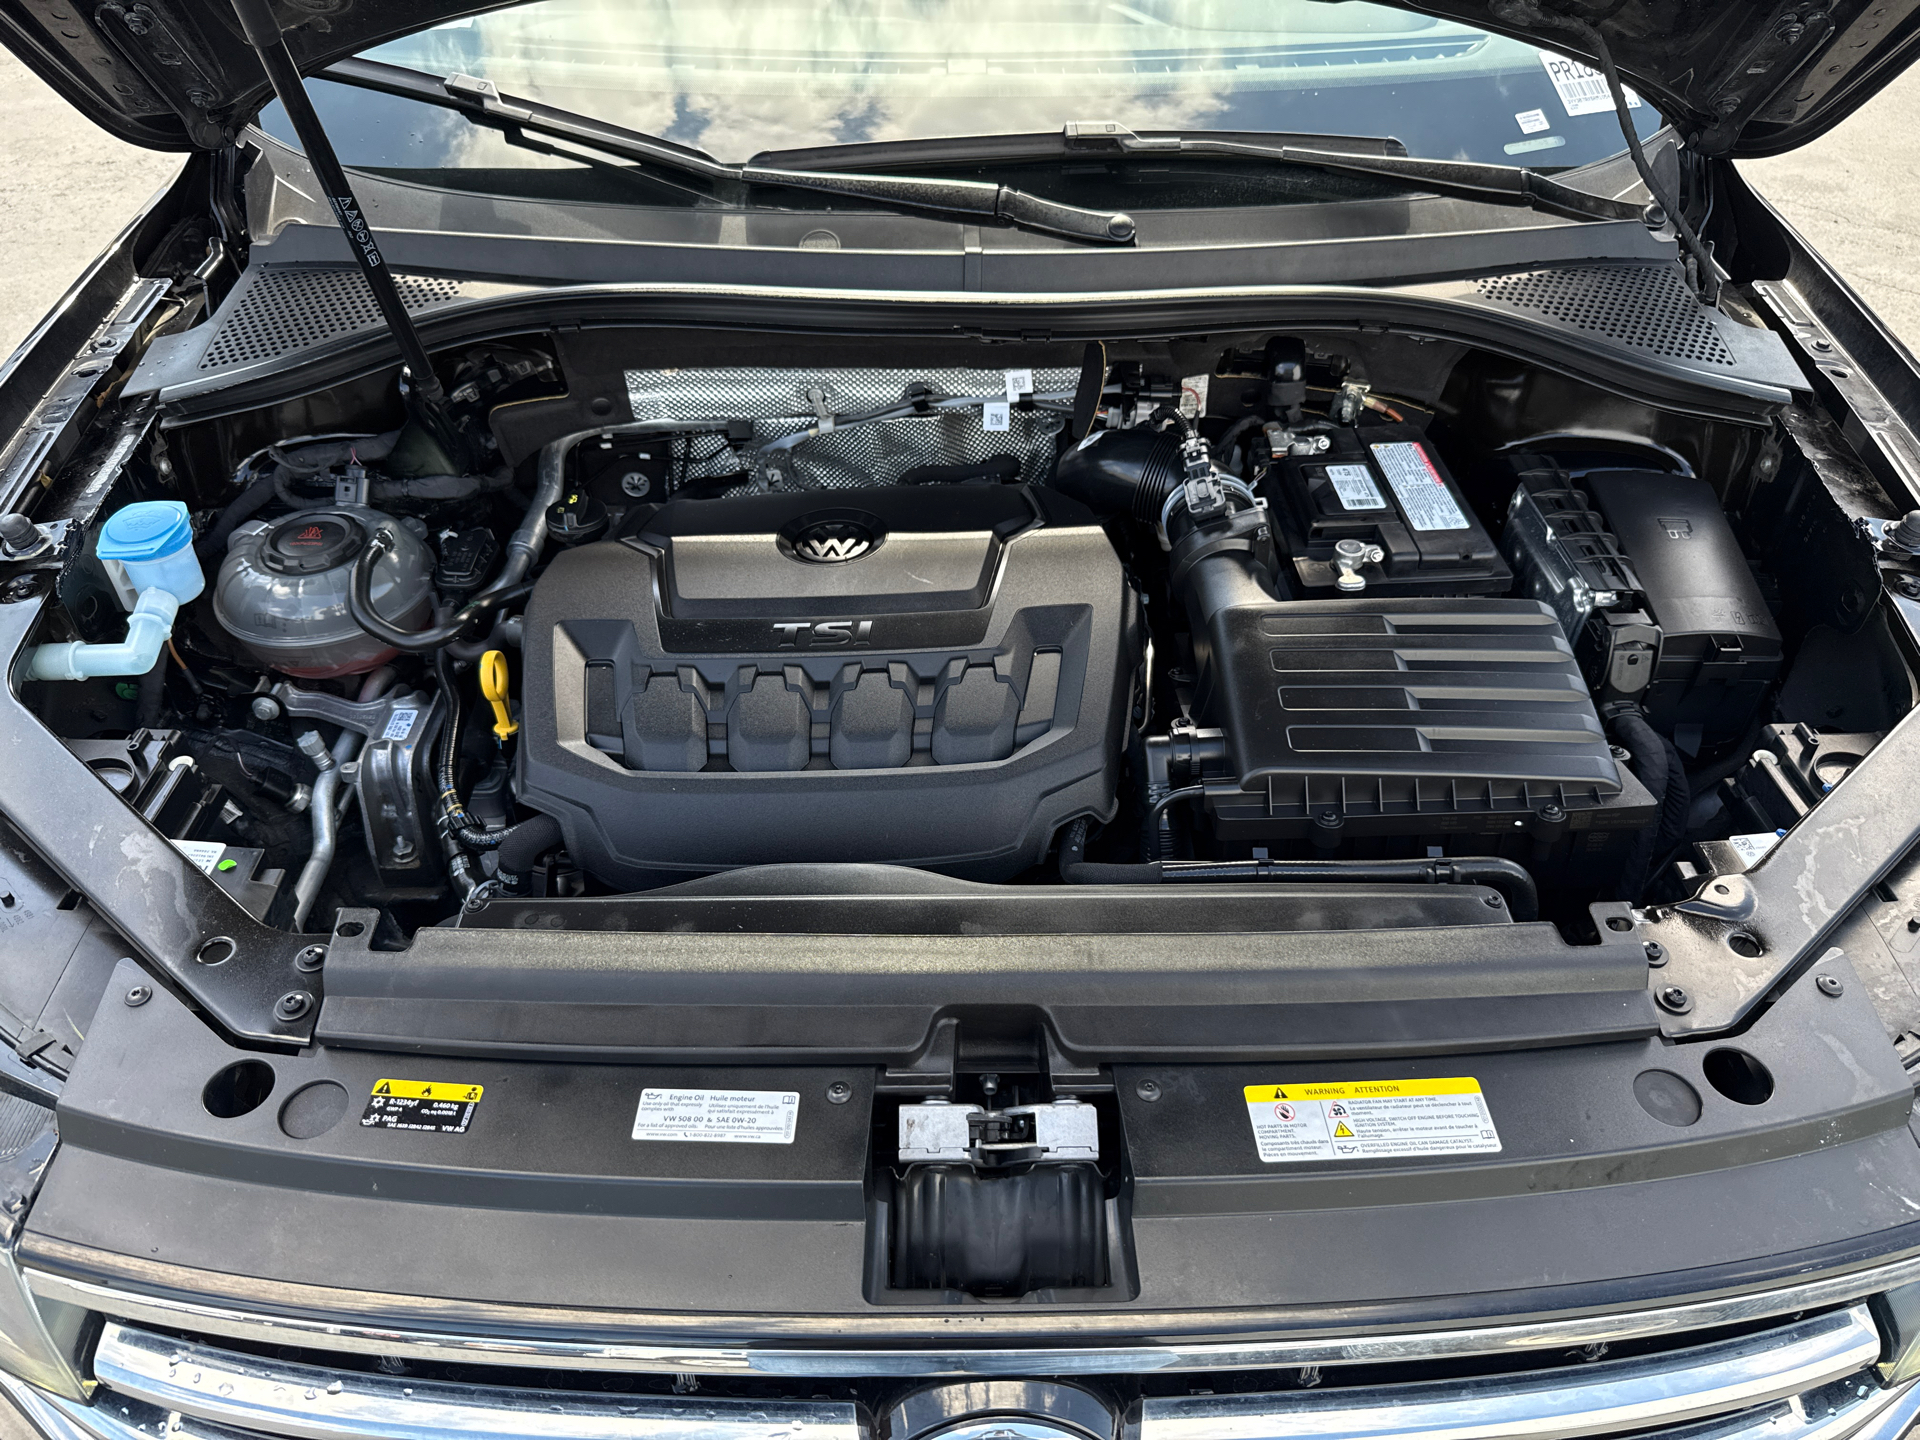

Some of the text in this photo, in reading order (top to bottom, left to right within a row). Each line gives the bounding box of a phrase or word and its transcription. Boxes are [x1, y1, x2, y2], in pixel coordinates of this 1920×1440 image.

[772, 620, 872, 647] TSI
[1304, 1087, 1345, 1095] WARNING
[388, 1098, 419, 1107] R-1234yf
